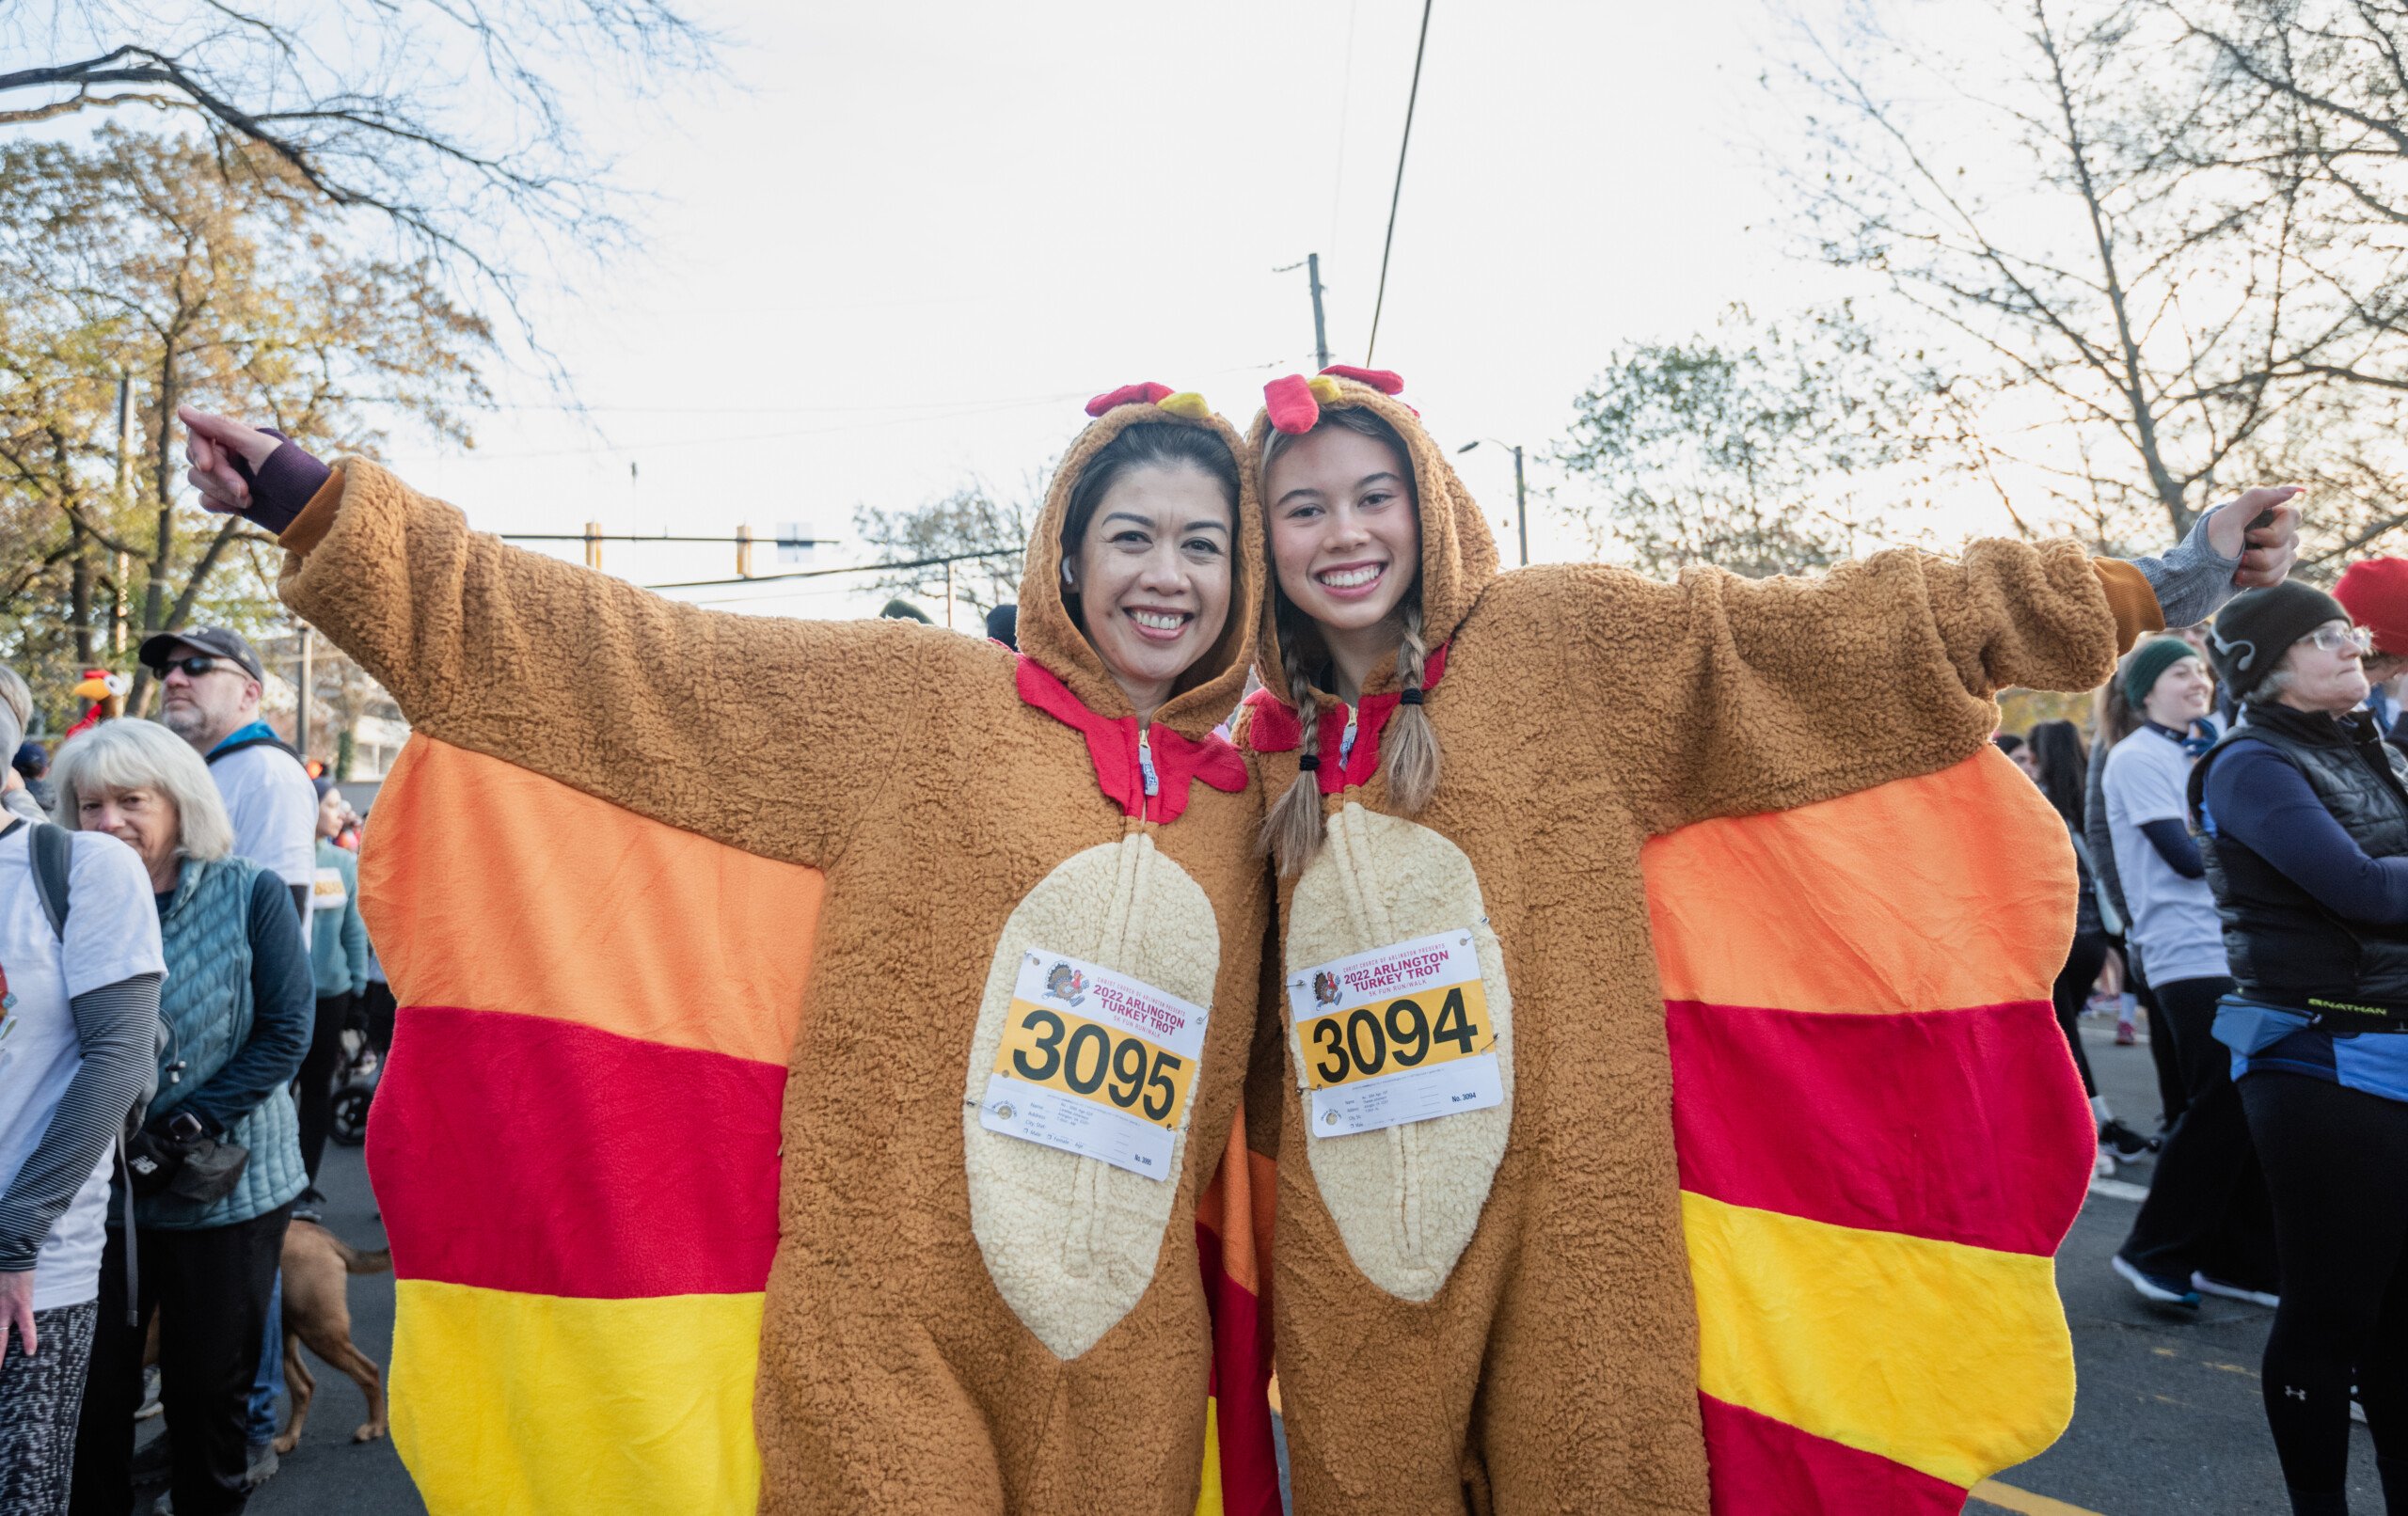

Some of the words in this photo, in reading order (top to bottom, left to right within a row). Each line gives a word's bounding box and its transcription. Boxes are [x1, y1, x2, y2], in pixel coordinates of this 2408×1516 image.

[1344, 970, 1370, 985] 2022
[1374, 950, 1450, 976] ARLINGTON
[1360, 959, 1378, 969] CHURCH
[1388, 951, 1417, 960] ARLINGTON
[1418, 943, 1446, 954] PRESENTS
[1354, 972, 1402, 992] TURKEY
[1406, 963, 1441, 979] TROT
[1393, 979, 1427, 990] RUN/WALK
[1093, 985, 1123, 1003] 2022
[1126, 997, 1185, 1029] ARLINGTON
[1101, 998, 1148, 1023] TURKEY
[1150, 1017, 1175, 1035] TROT
[2322, 1001, 2387, 1016] NATHAN
[1122, 1018, 1133, 1027] FUN
[1313, 987, 1479, 1083] 3094
[1013, 1009, 1181, 1121] 3095
[1463, 1092, 1476, 1100] 3094
